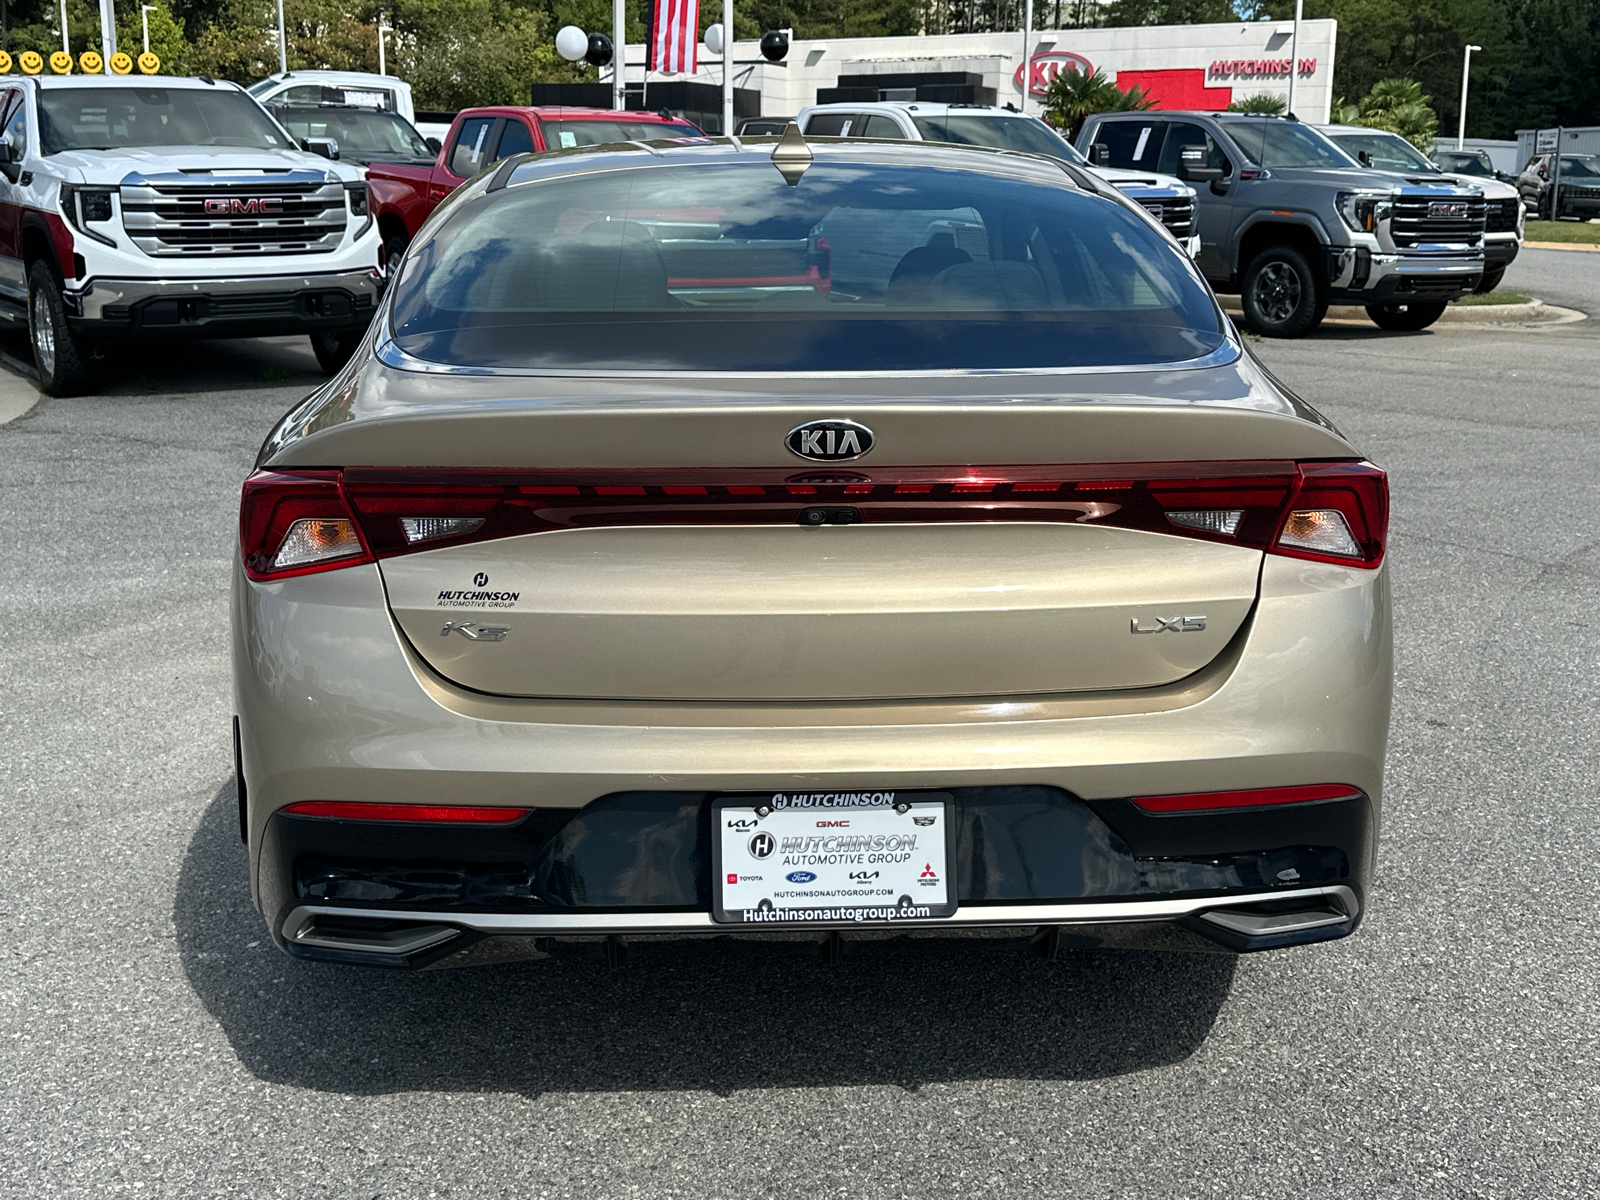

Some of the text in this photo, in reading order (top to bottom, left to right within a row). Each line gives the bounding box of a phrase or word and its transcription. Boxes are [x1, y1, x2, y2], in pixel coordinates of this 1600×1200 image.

[204, 198, 283, 214] GMC
[800, 430, 862, 454] KIA
[437, 591, 520, 601] HUTCHINSON
[790, 792, 895, 808] HUTCHINSON
[727, 819, 758, 828] KIA
[780, 835, 917, 853] HUTCHINSON
[782, 852, 911, 866] AUTOMOTIVE GROUP
[791, 872, 812, 882] Ford
[849, 871, 879, 880] KIA
[774, 888, 894, 899] HUTCHINSONAUTOGROUP.COM
[743, 905, 930, 922] Hutchinsonautogroup.com
